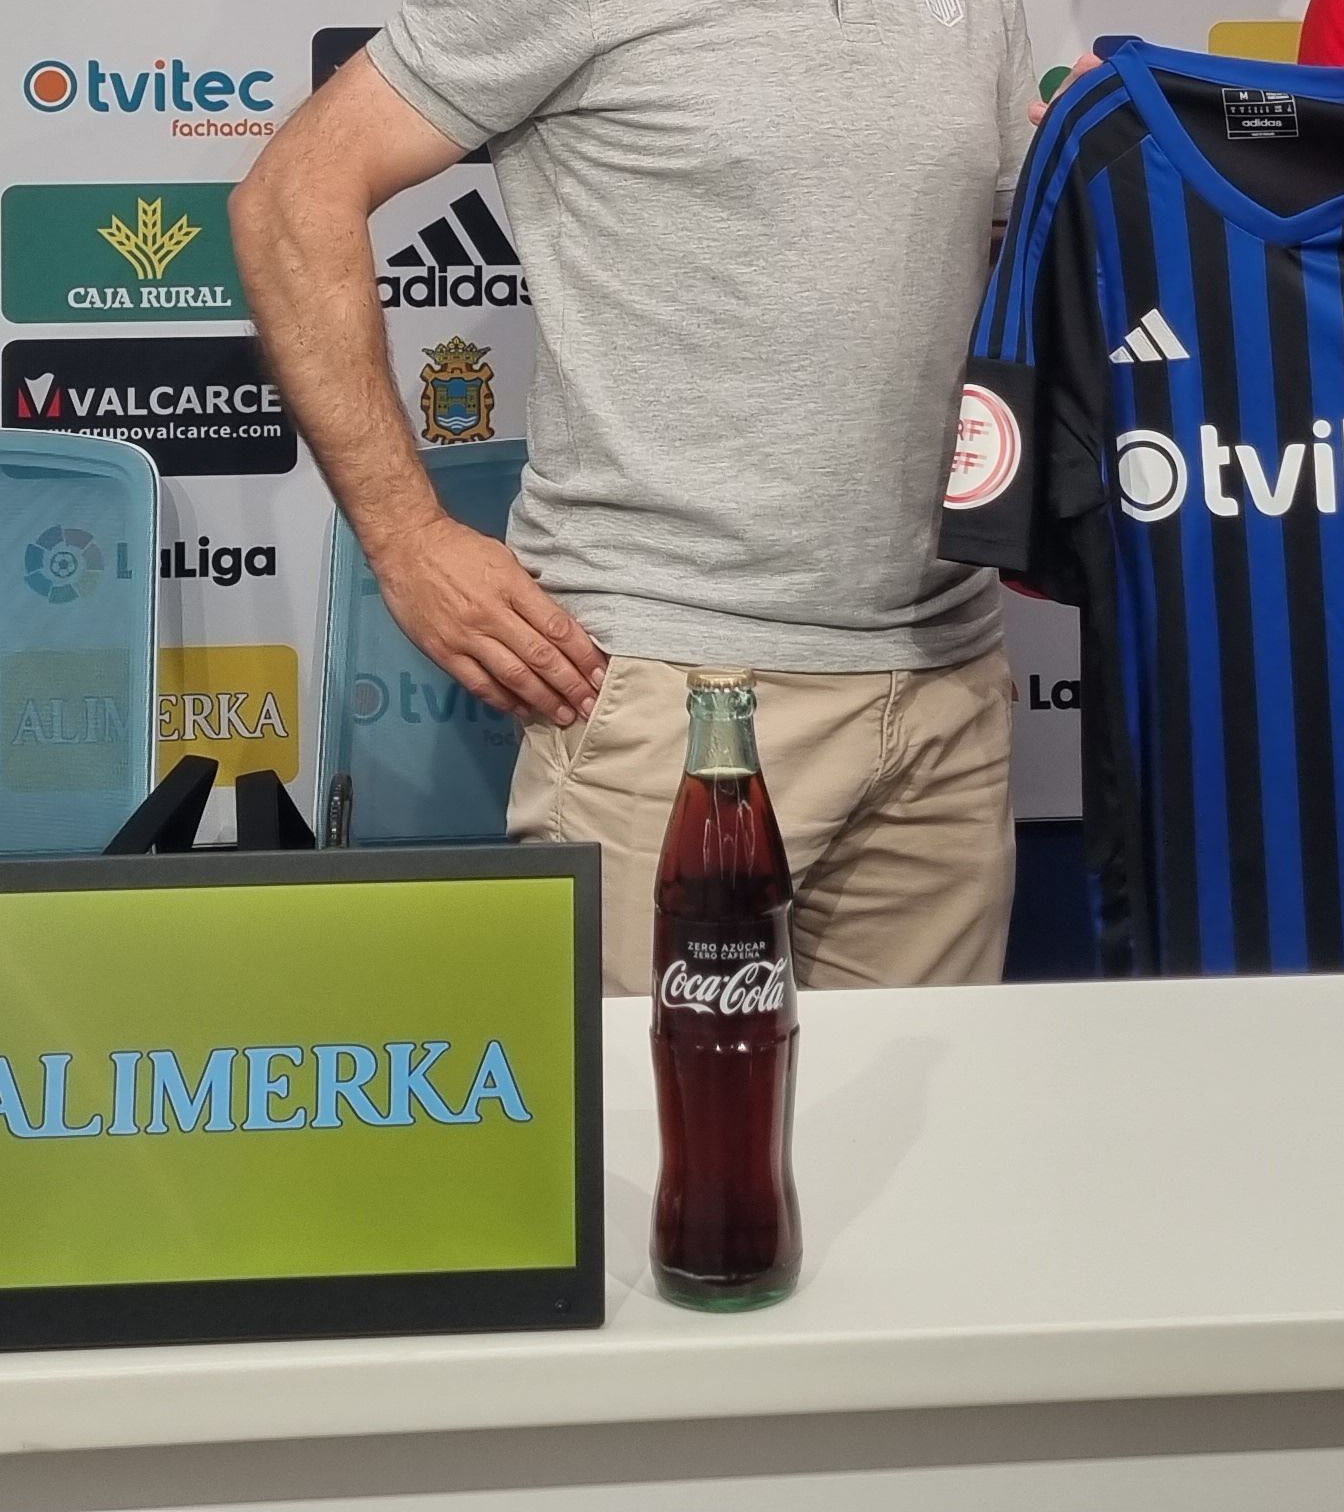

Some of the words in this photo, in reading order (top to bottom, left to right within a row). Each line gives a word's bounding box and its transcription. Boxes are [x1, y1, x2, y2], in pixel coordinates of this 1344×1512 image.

[89, 60, 273, 112] tvitec
[1239, 91, 1248, 100] M
[172, 119, 274, 137] fachadas
[1242, 119, 1282, 127] adidas
[68, 288, 133, 309] CAJA
[140, 287, 231, 307] RURAL
[68, 385, 281, 416] VALCARCE
[688, 942, 717, 952] ZERO
[721, 941, 766, 952] AZÚCAR
[693, 951, 718, 960] ZERO
[662, 958, 788, 1015] Coca-Cola
